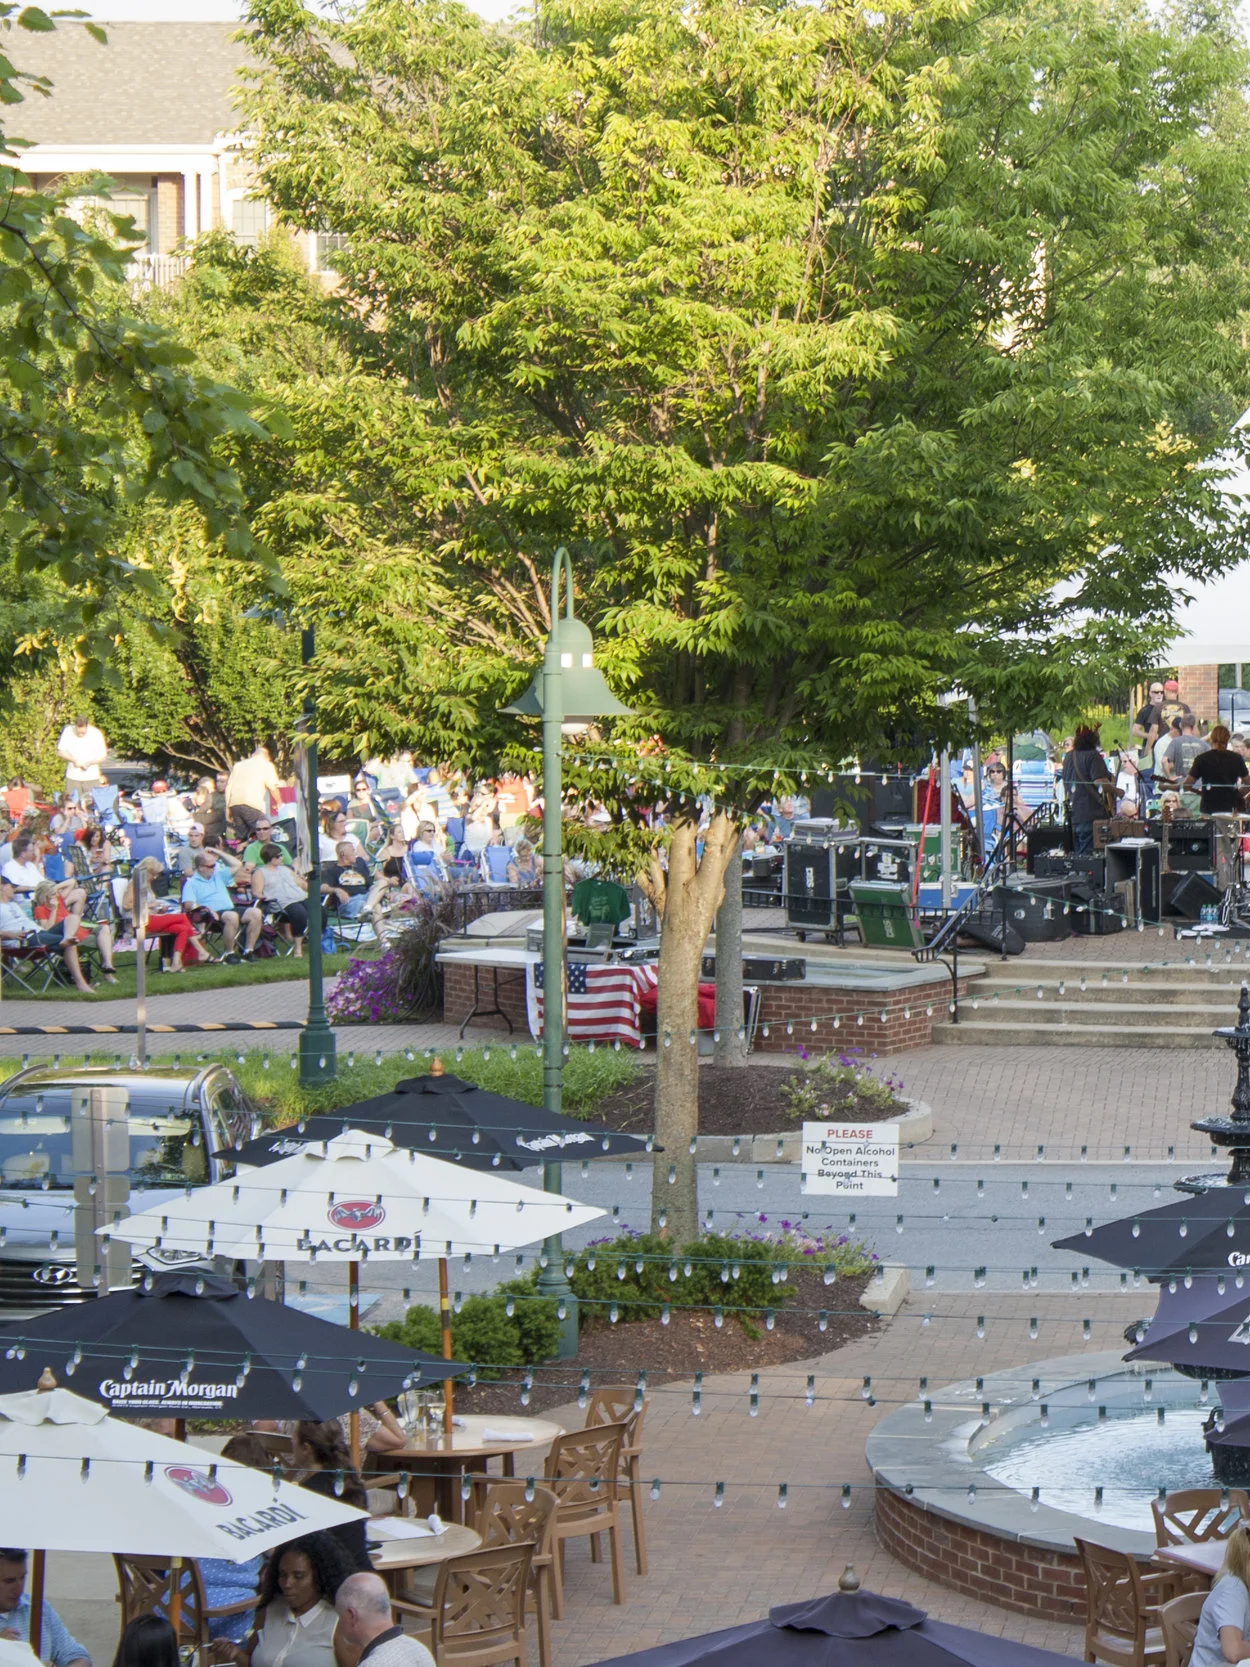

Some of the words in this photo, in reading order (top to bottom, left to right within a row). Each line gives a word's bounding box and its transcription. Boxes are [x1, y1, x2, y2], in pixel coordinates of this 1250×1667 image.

[827, 1129, 873, 1139] PLEASE
[806, 1146, 820, 1154] No
[824, 1146, 852, 1157] Open
[856, 1147, 895, 1156] Alcohol
[821, 1158, 879, 1167] Containers
[861, 1170, 883, 1178] This
[836, 1181, 863, 1190] Point
[99, 1379, 166, 1398] Captain
[162, 1380, 238, 1399] Morgan
